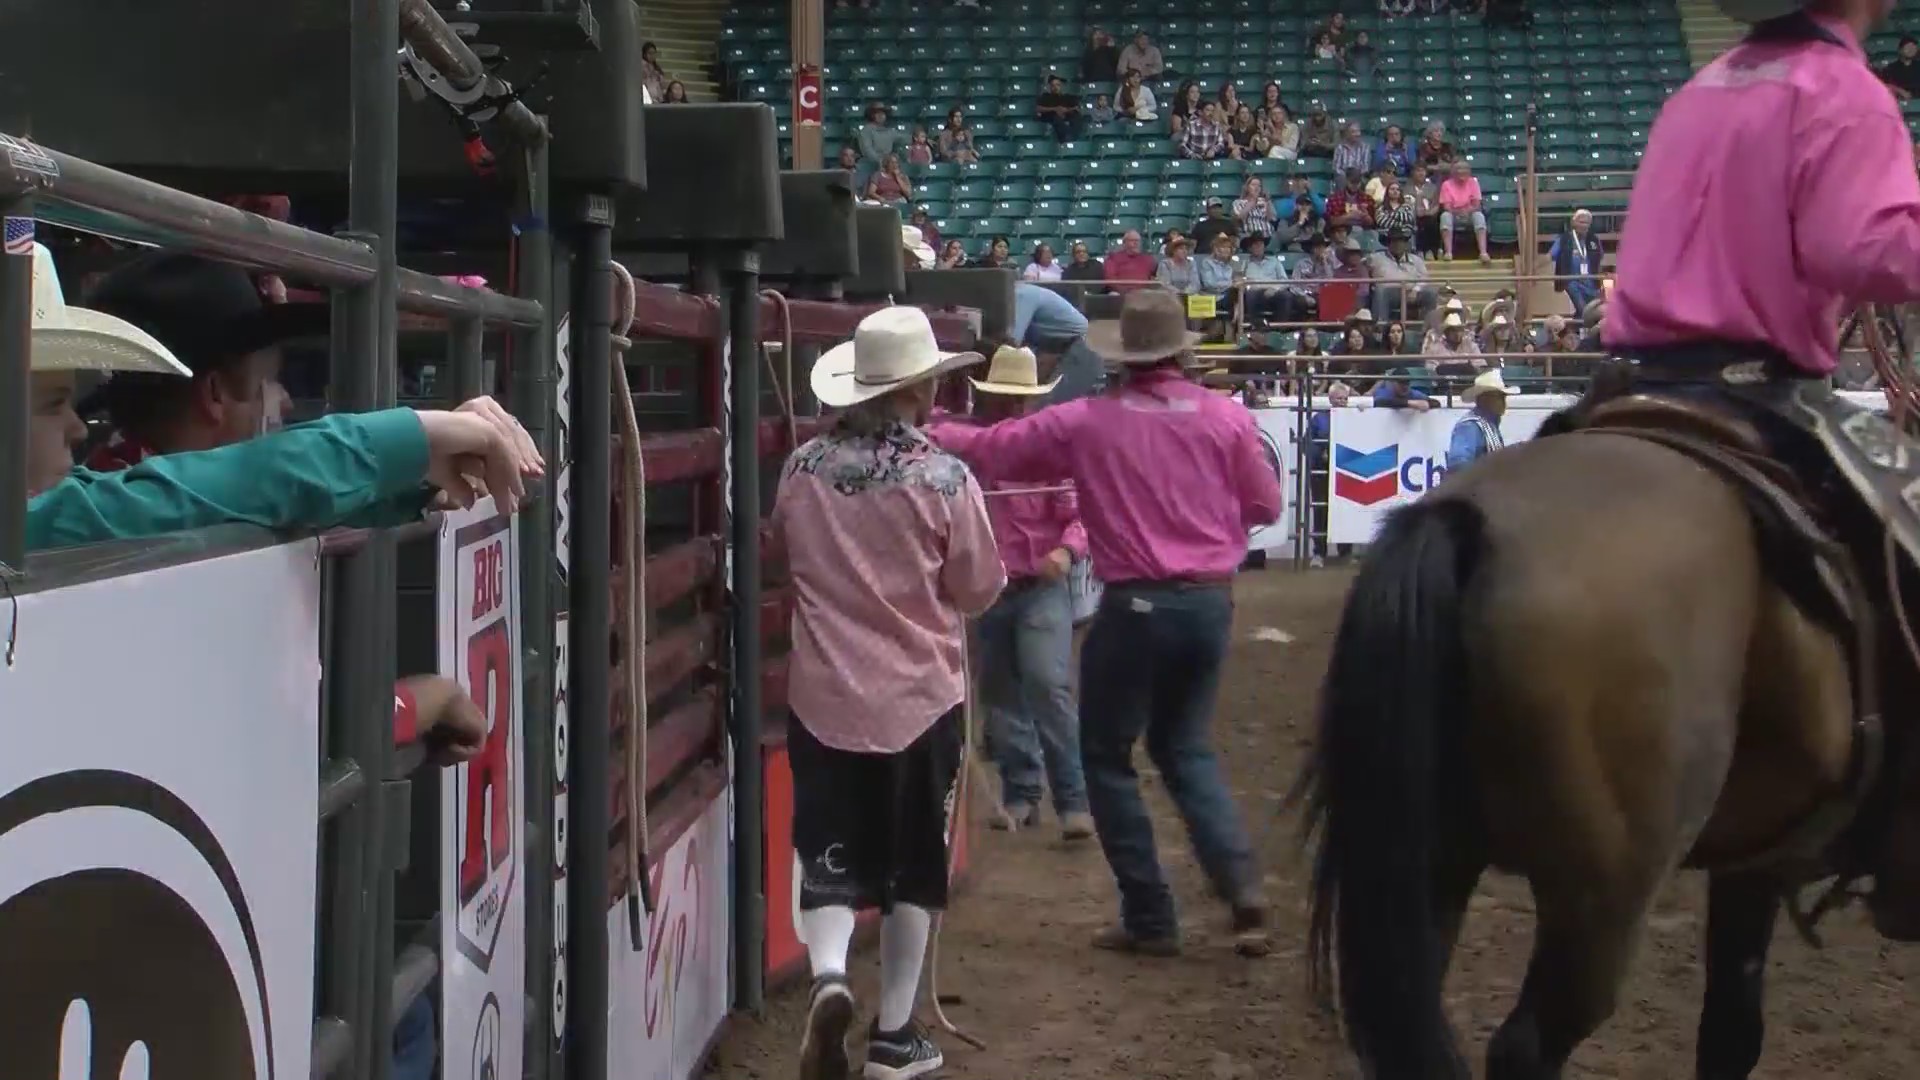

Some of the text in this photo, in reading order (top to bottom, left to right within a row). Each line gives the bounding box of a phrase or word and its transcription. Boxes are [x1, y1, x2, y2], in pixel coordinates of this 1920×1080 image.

[800, 85, 818, 108] C
[472, 539, 503, 621] BIG
[461, 616, 512, 910] R
[554, 615, 569, 1041] RODEO
